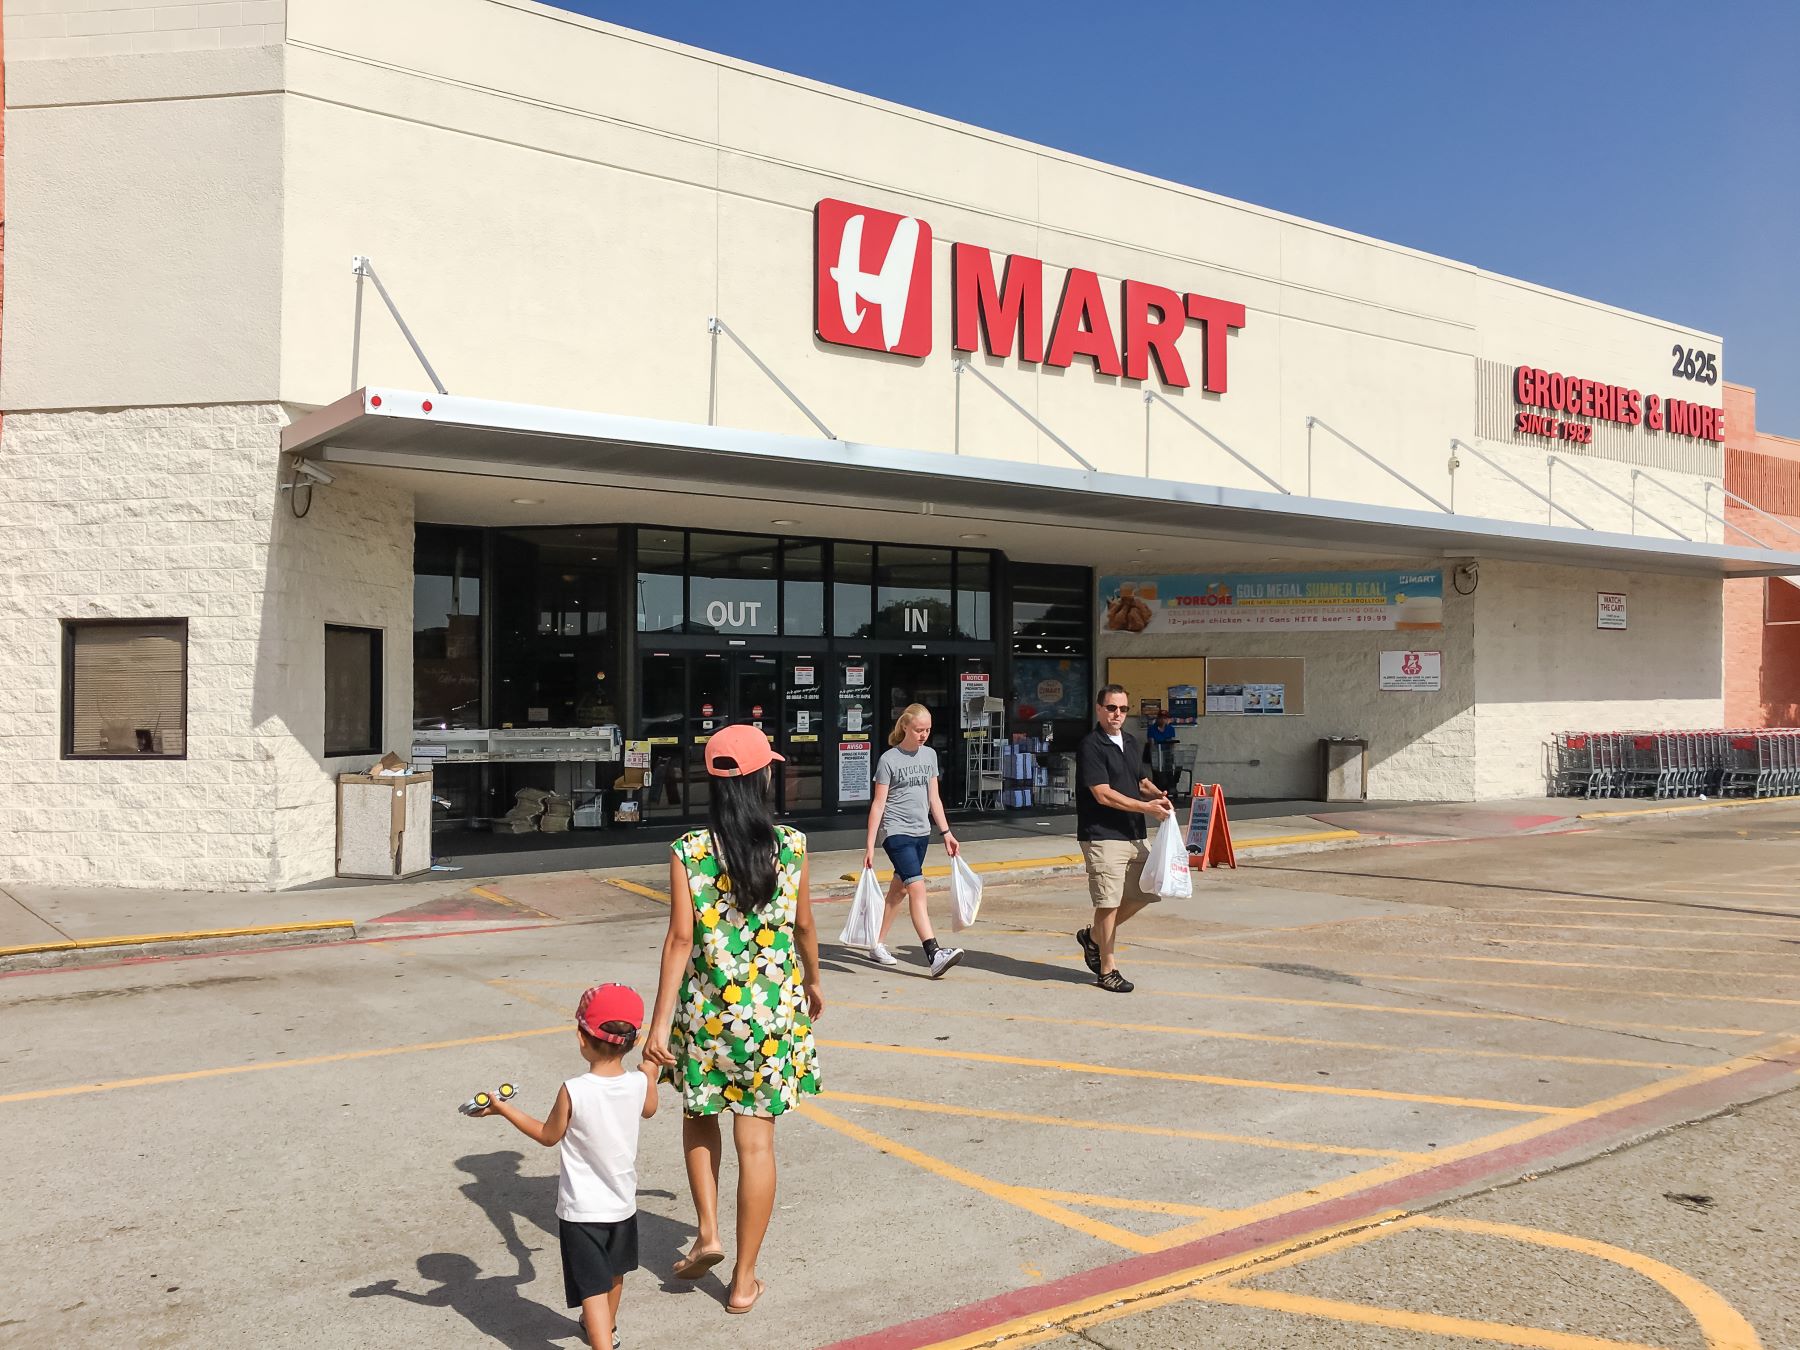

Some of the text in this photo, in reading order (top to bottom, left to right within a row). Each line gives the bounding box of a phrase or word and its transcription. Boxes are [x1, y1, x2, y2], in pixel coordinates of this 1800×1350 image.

[828, 213, 1246, 394] H MART
[1672, 344, 1718, 386] 2625
[1513, 365, 1726, 443] GROCERIES & MORE
[1514, 411, 1593, 445] SINCE 1982
[1236, 583, 1264, 599] GOLD
[1266, 583, 1303, 598] MEDAL
[1305, 582, 1353, 597] SUMMER
[1603, 596, 1622, 604] WATCH
[706, 600, 762, 627] OUT
[903, 607, 929, 633] IN
[1600, 603, 1611, 611] THE
